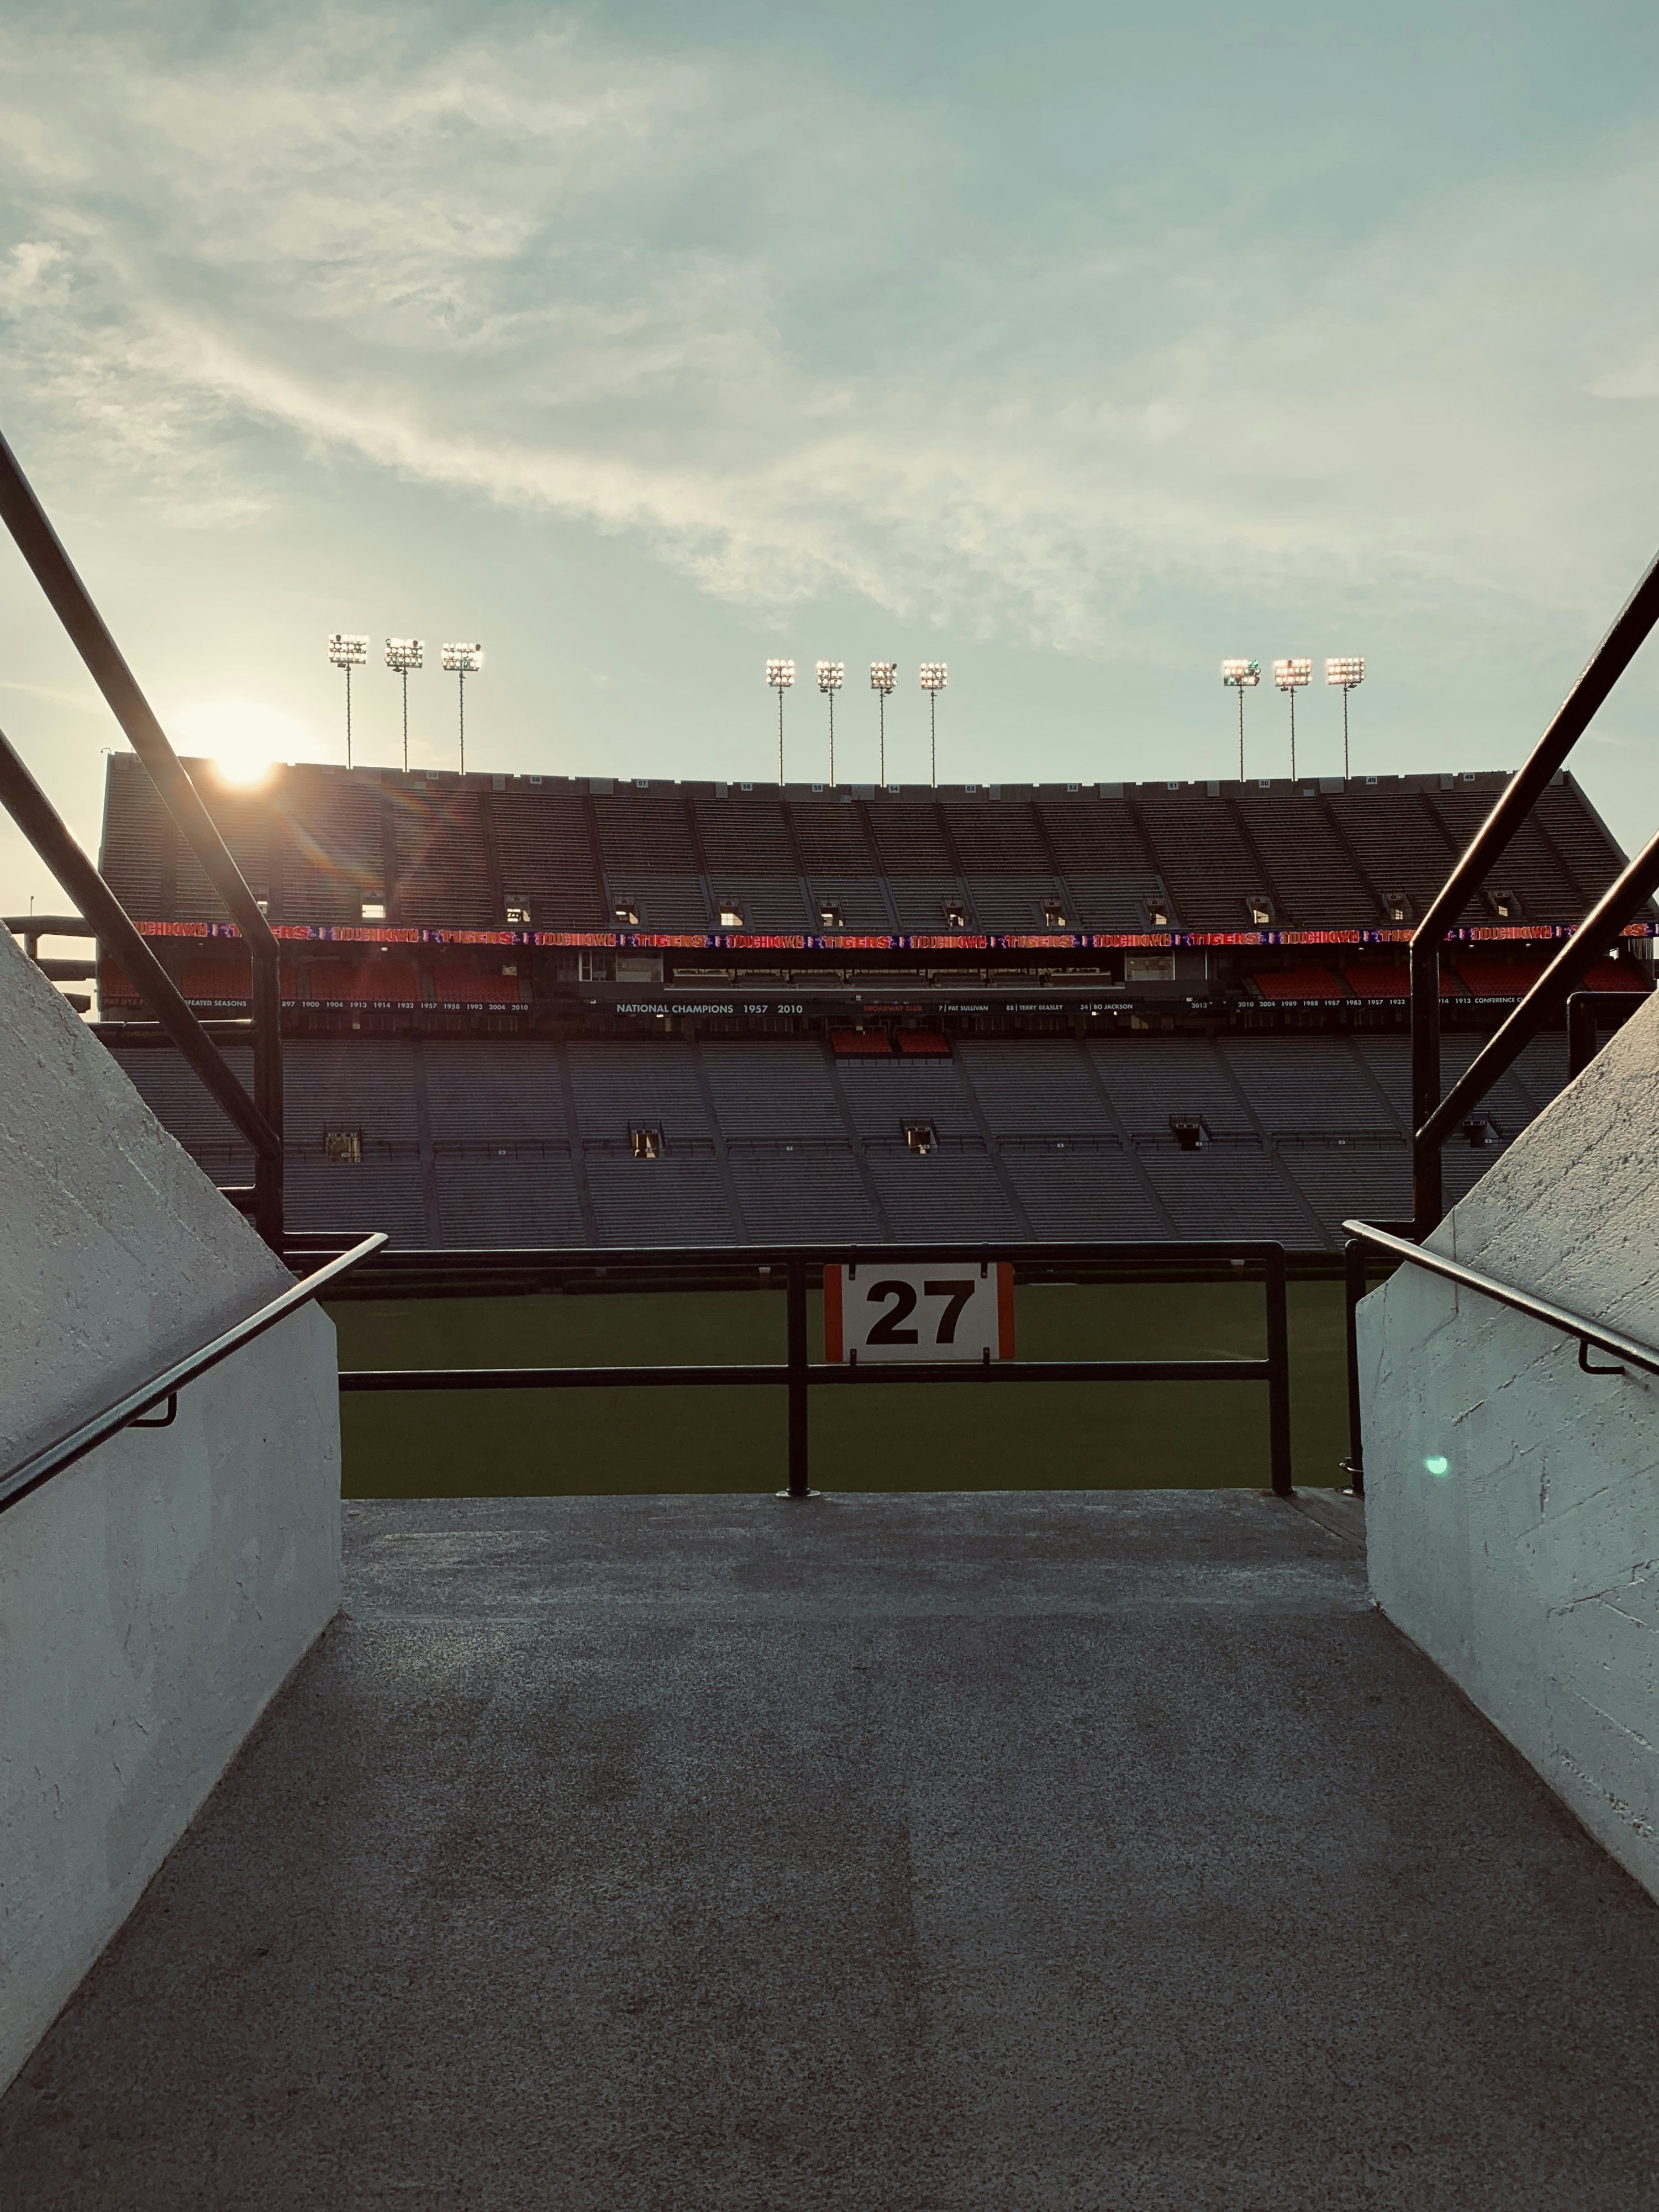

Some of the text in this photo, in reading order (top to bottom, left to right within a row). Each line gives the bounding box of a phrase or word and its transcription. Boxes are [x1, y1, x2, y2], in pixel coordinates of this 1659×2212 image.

[134, 921, 207, 937] UCHDOWN
[333, 927, 418, 942] TOUCHDOWN
[440, 930, 513, 944] TIGERS
[536, 933, 615, 946] TOUCHDOWN
[635, 934, 705, 947] TIGERS
[728, 935, 803, 949] TOUCHDOWN
[823, 935, 890, 949] TIGERS
[911, 935, 986, 949] TOUCHDOWN
[1005, 935, 1073, 949] TIGERS
[1094, 934, 1171, 947] TOUCHDOWN
[1191, 932, 1260, 946] TIGERS
[1282, 930, 1359, 944] TOUCHDOWN
[1472, 926, 1552, 941] TOUCHDOWN
[617, 1004, 803, 1013] NATIONAL CHAMPIONS 1957 2010
[866, 1279, 975, 1345] 27
